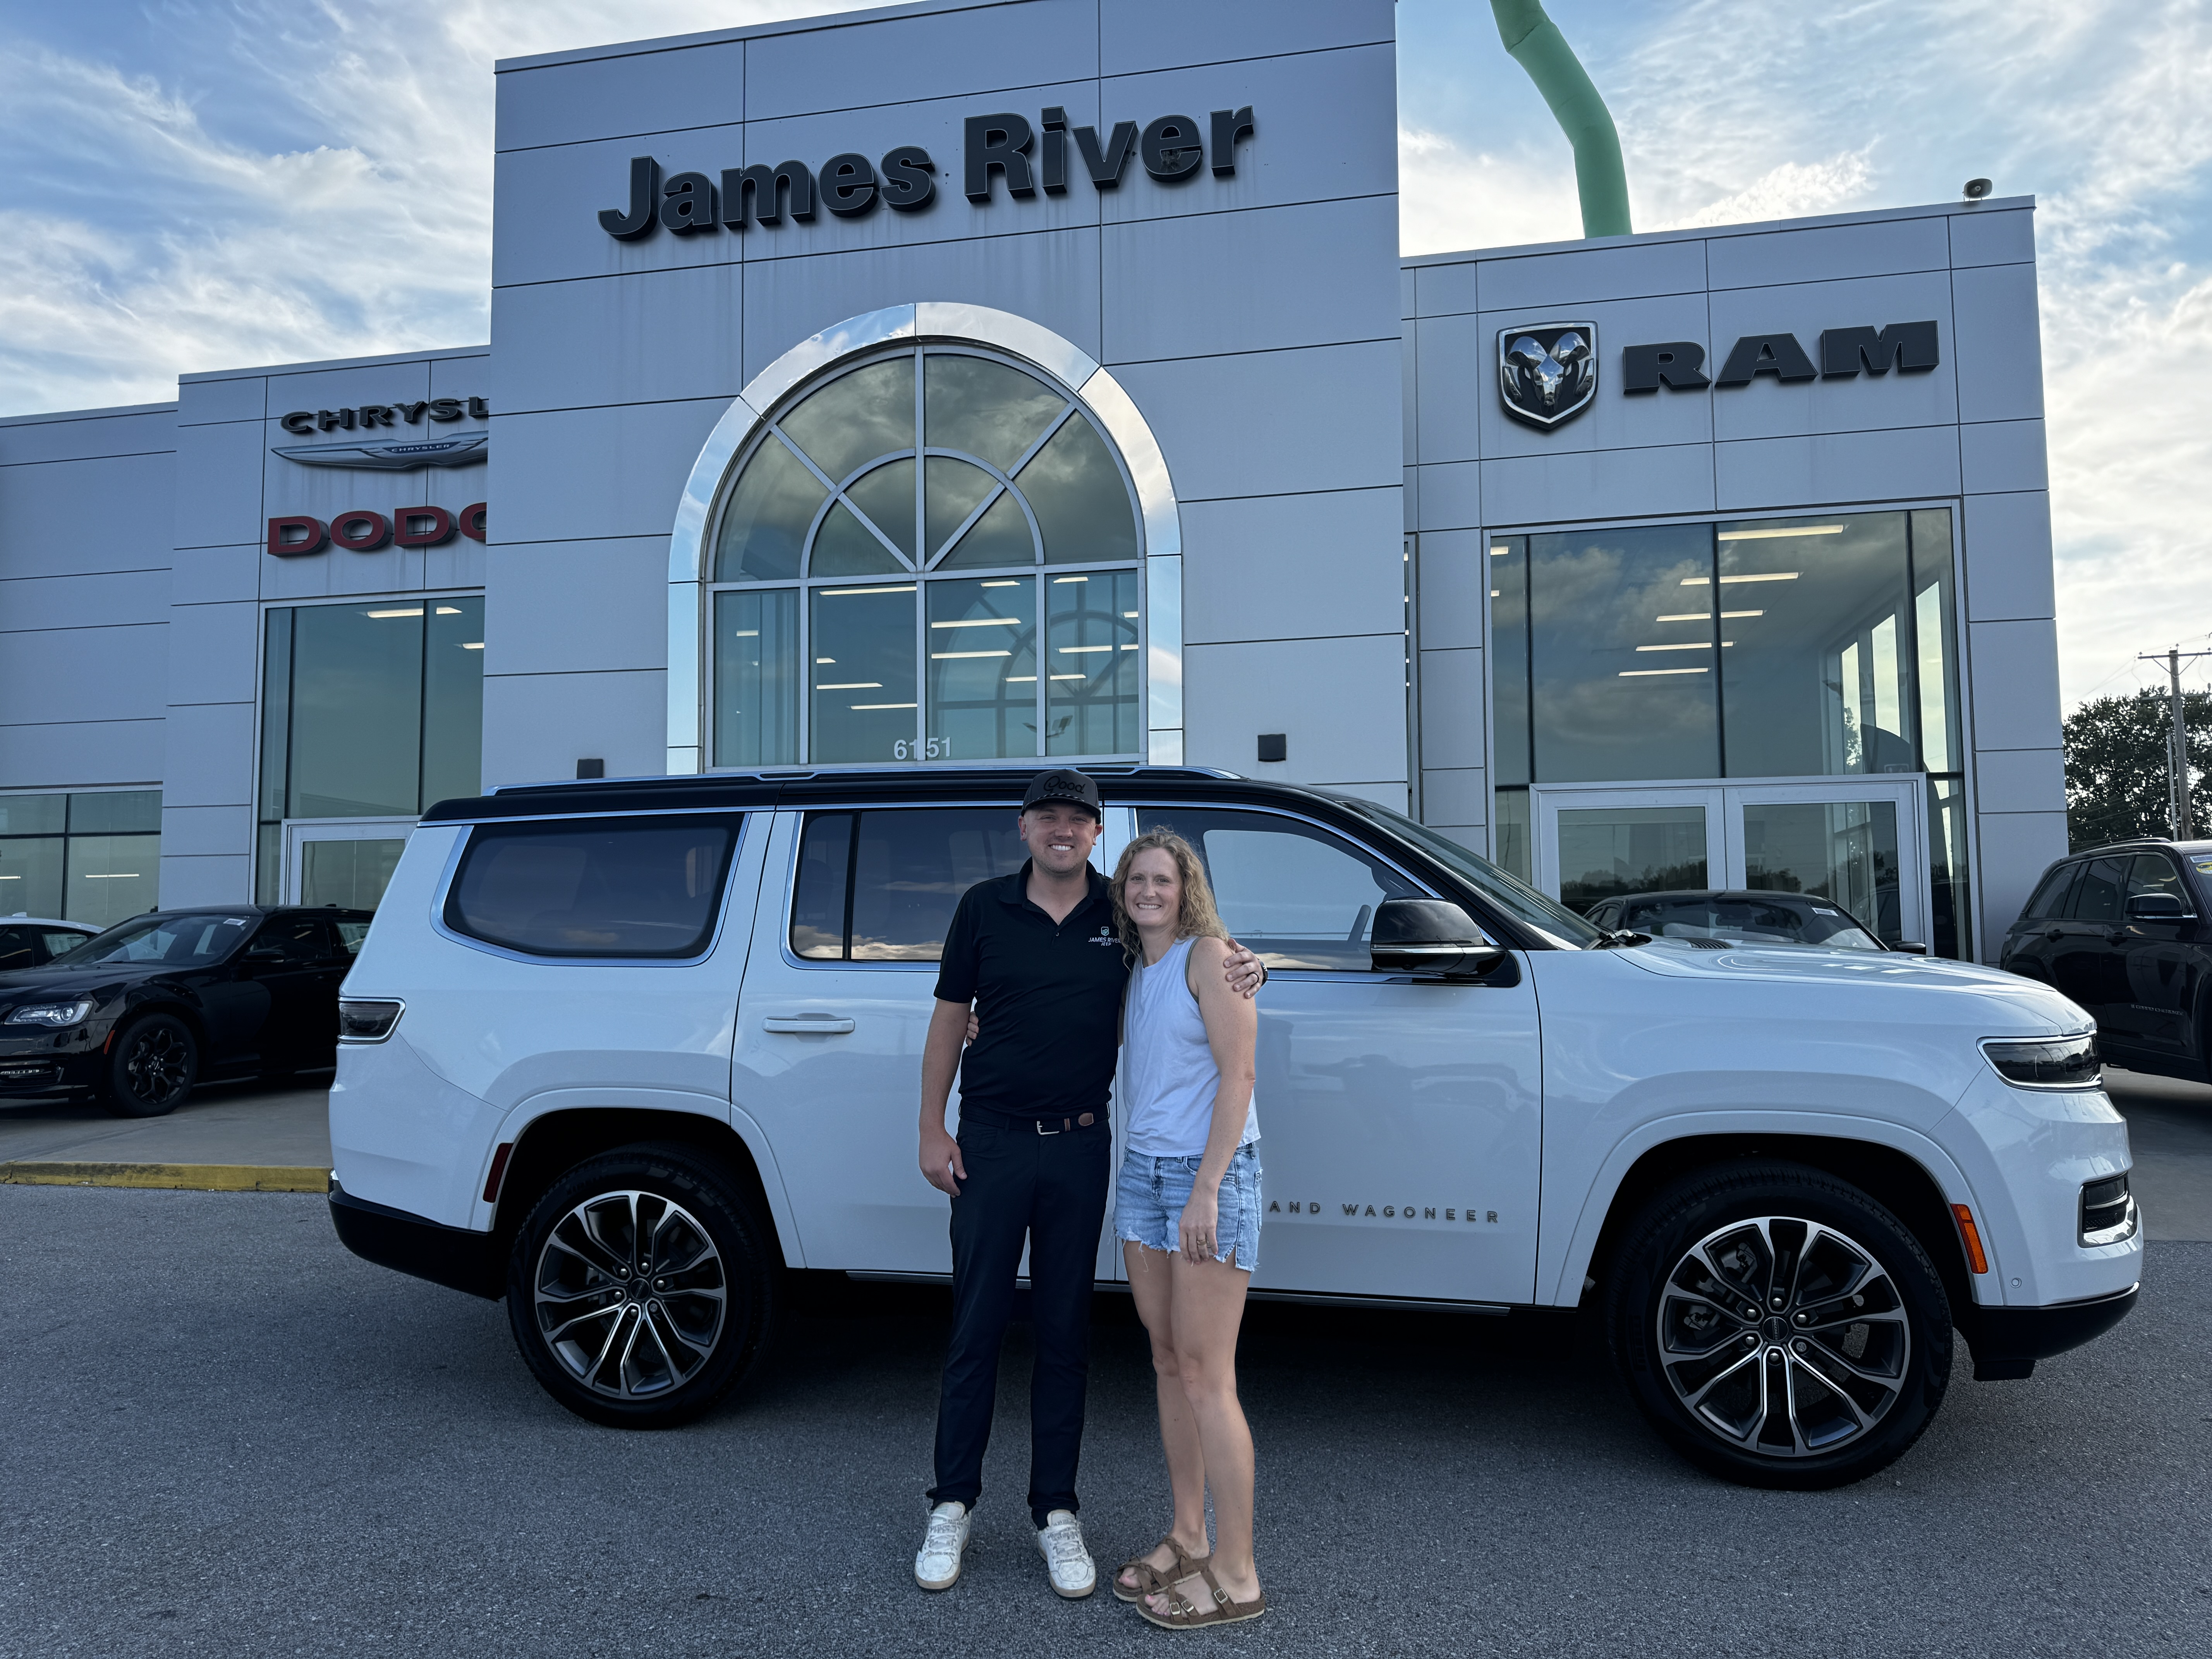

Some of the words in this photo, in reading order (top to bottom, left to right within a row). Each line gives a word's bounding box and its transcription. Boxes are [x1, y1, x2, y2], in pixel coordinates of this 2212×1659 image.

[598, 156, 936, 241] James
[964, 105, 1253, 203] River
[1623, 320, 1939, 395] RAM
[280, 397, 489, 433] CHRYSL
[894, 737, 950, 760] 6151
[1270, 1201, 1320, 1214] AND
[1343, 1204, 1498, 1223] WAGONEER
